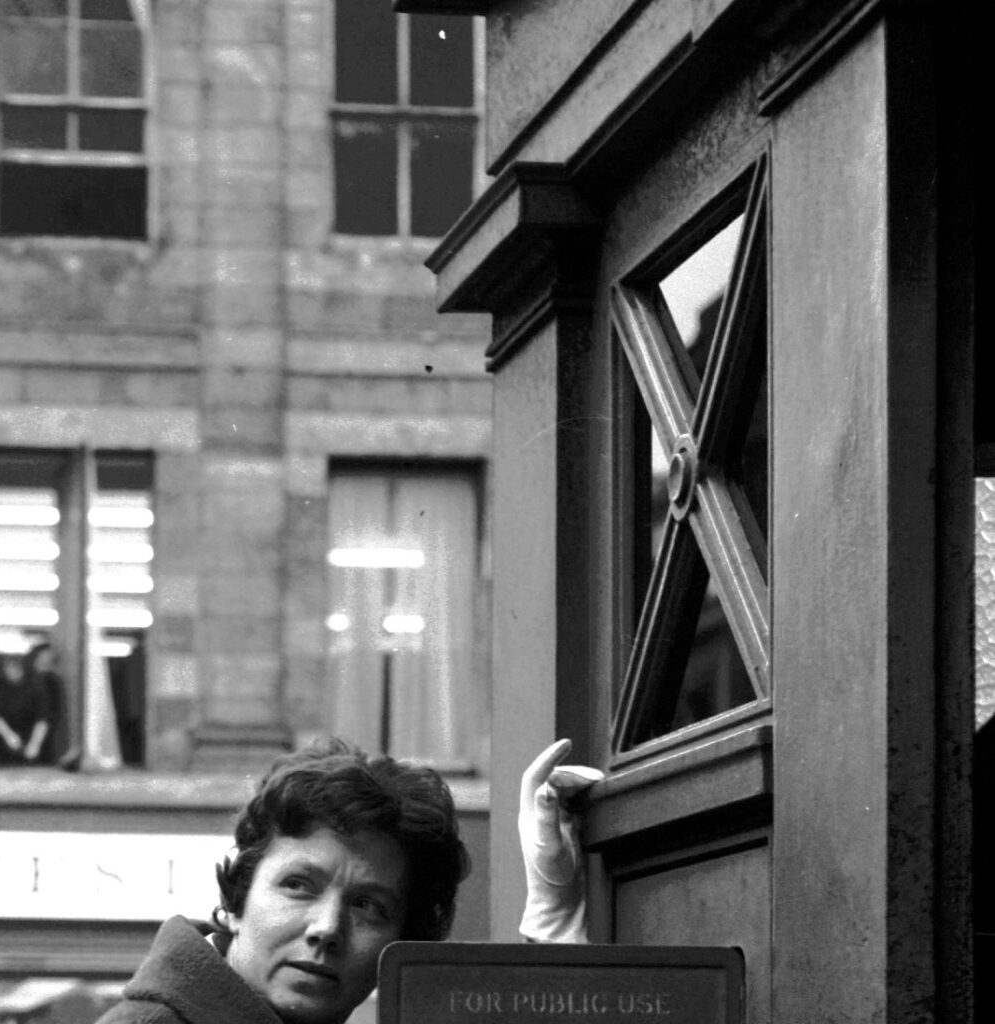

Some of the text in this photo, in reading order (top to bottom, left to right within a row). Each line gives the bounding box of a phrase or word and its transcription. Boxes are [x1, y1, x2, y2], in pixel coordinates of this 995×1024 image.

[449, 992, 671, 1014] FOR PUBLIC USE
